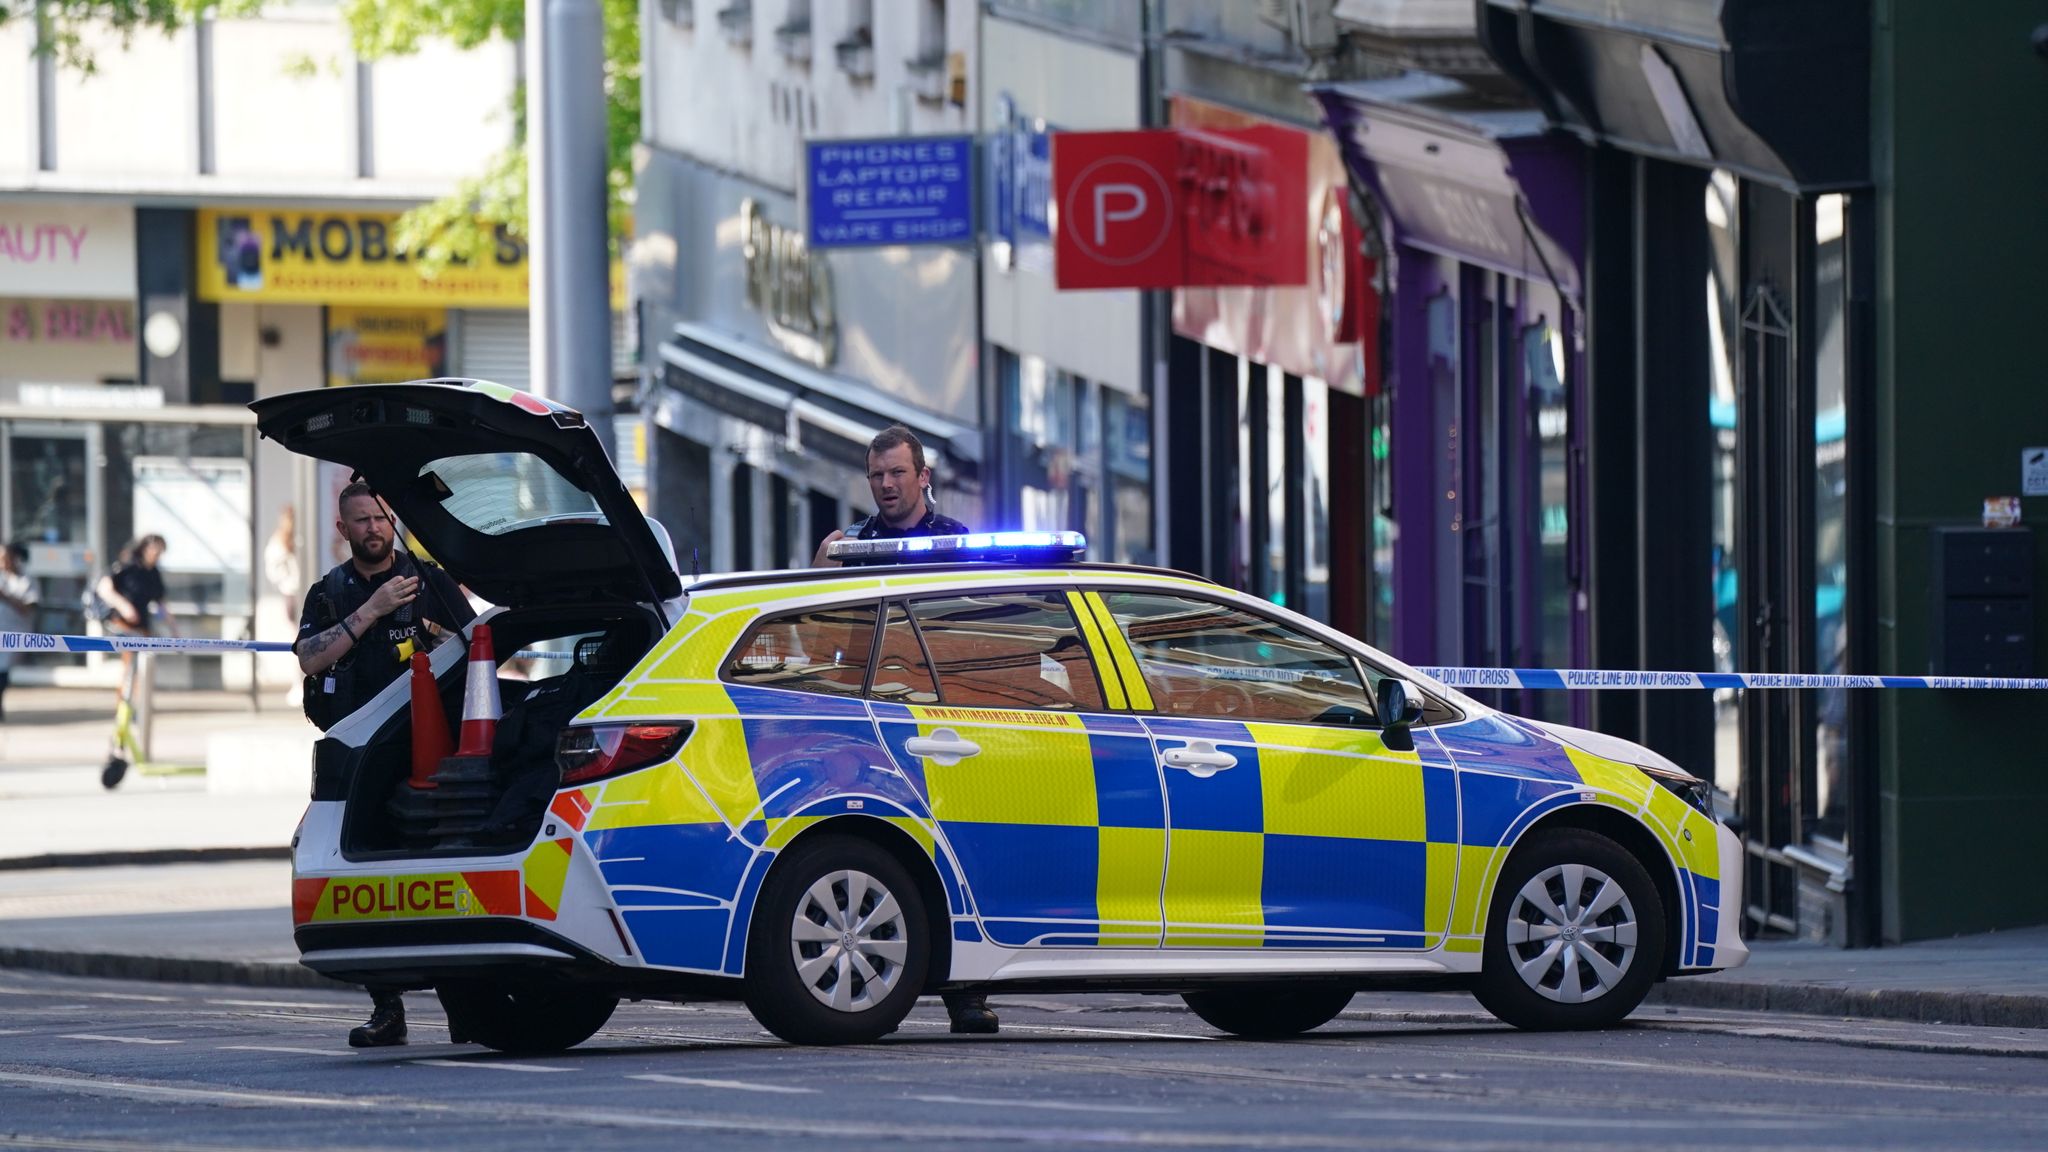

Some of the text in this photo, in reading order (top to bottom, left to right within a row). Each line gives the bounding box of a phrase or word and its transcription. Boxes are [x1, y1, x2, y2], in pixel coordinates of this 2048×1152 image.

[821, 143, 956, 165] PHONES
[817, 164, 961, 187] LAPTOPS
[832, 184, 948, 207] REPAIR
[1094, 183, 1147, 245] P
[817, 218, 967, 240] VAPE SHOP
[3, 633, 56, 648] NOT CROSS
[389, 626, 417, 640] POLICE
[1444, 669, 1456, 684] DO
[1459, 669, 1477, 684] NOT
[1479, 669, 1510, 685] CROSS
[1568, 671, 1692, 686] POLICE LINE DO NOT CROSS
[1750, 674, 1874, 688] POLICE LINE DO NOT CROSS
[1933, 678, 1966, 688] POLICE
[1968, 678, 1988, 689] LINE
[1991, 679, 2004, 689] DO
[2007, 679, 2024, 689] NOT
[333, 880, 455, 914] POLICE
